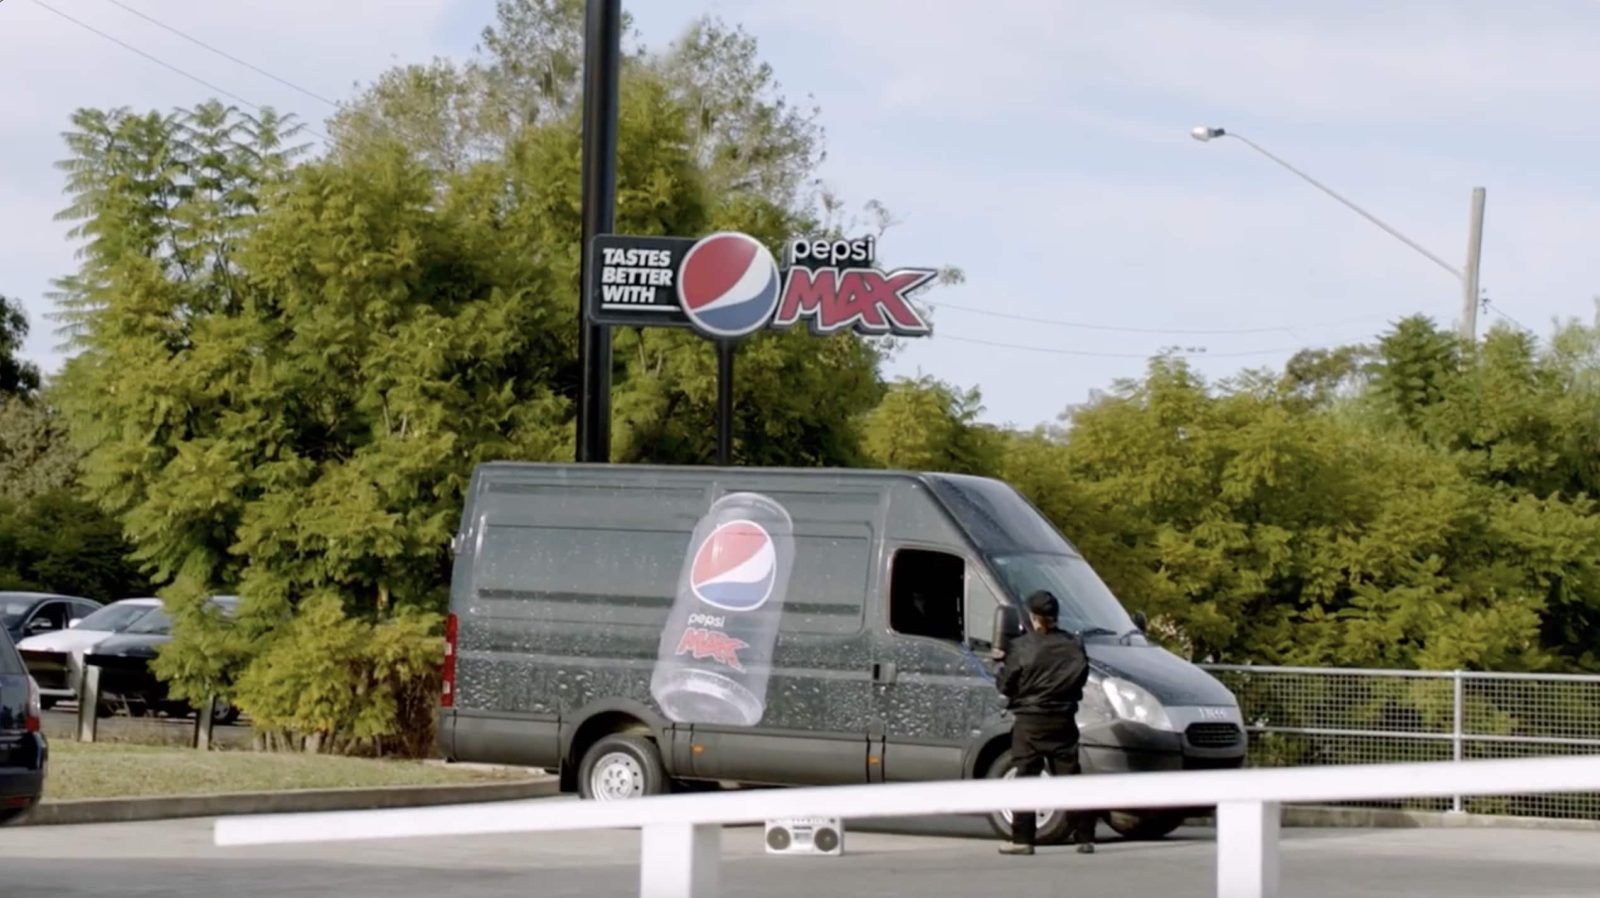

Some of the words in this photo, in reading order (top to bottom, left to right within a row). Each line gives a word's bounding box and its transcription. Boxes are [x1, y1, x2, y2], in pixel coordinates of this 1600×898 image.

[602, 248, 671, 267] TASTES
[791, 235, 876, 265] pepsi
[601, 266, 673, 286] BETTER
[601, 285, 656, 303] WITH
[773, 265, 938, 331] MAX
[687, 611, 725, 628] pepsi
[675, 627, 750, 674] MAX
